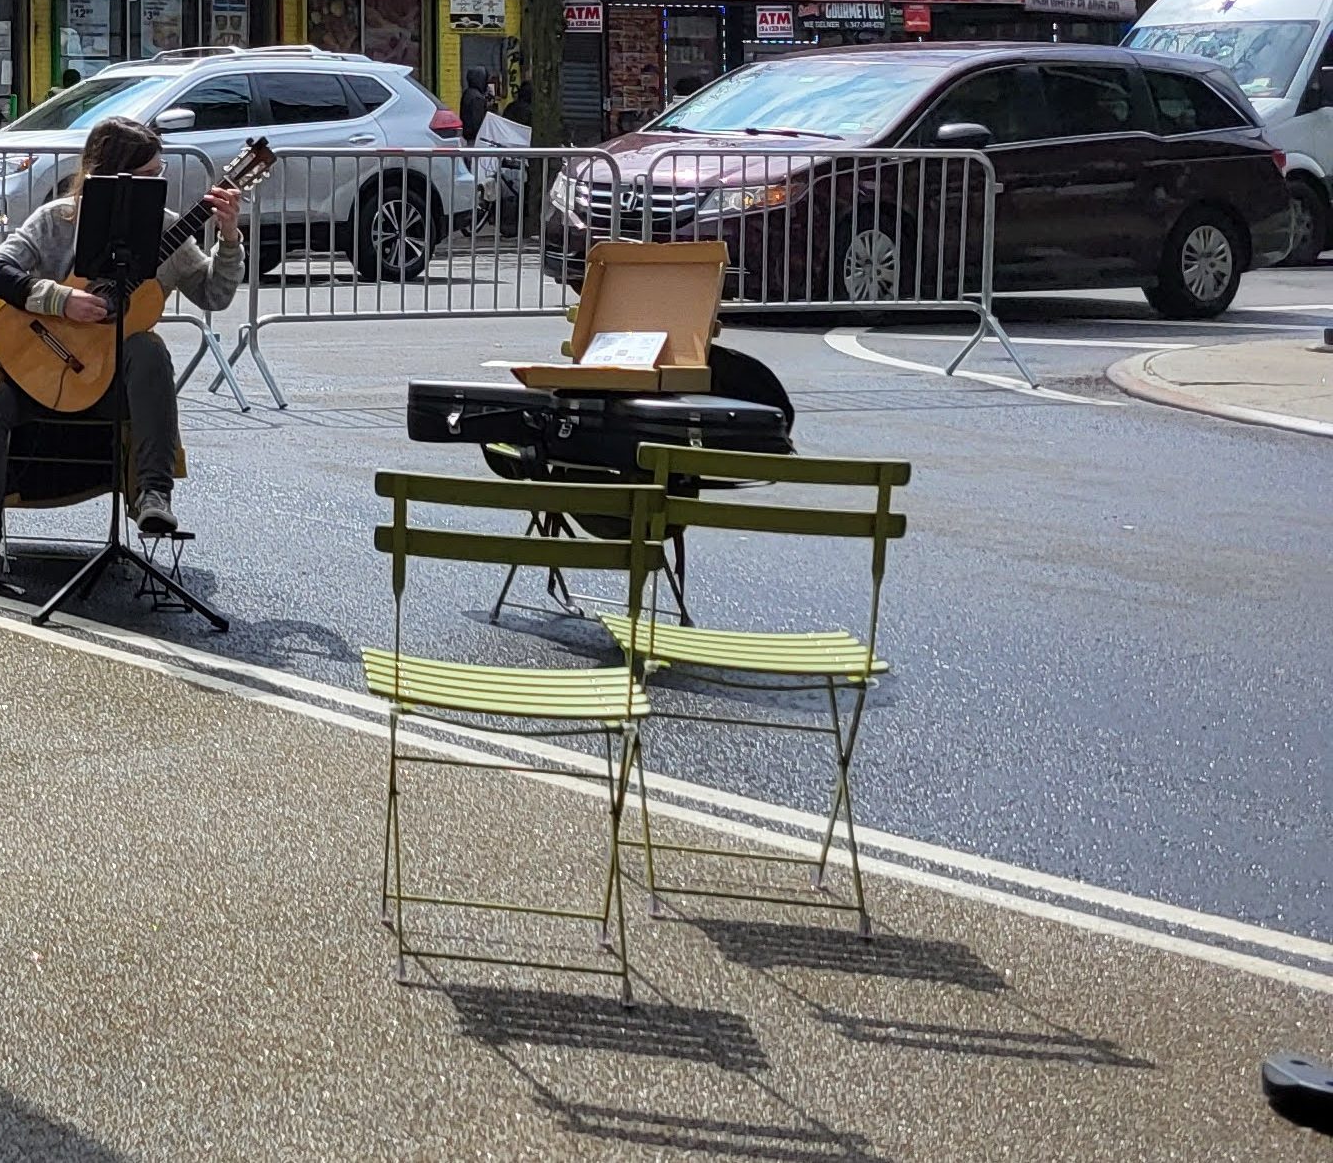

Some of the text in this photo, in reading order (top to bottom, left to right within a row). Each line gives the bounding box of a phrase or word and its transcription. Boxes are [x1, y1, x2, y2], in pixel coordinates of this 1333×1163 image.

[565, 6, 600, 20] ATM
[826, 3, 866, 18] GOURMET
[758, 12, 791, 25] ATM
